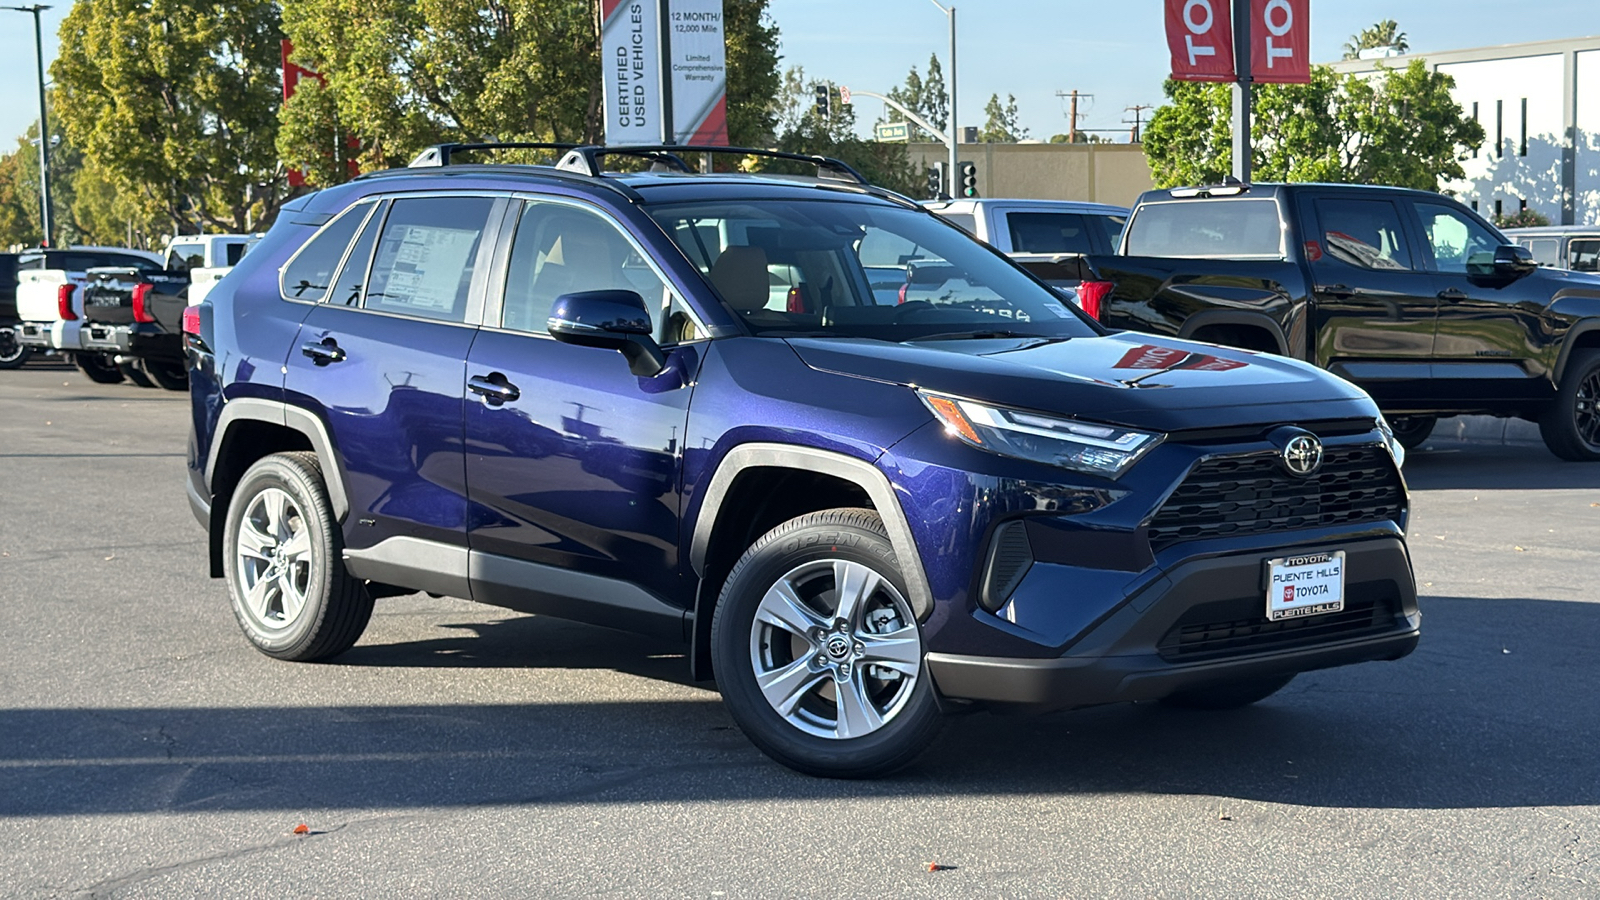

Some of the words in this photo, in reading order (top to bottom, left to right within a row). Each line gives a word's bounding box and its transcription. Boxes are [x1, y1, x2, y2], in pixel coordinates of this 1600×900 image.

[671, 12, 681, 21] 12
[683, 12, 721, 22] MONTH/
[675, 25, 700, 33] 12,000
[701, 25, 718, 33] Mile
[631, 4, 644, 80] VEHICLES
[673, 65, 723, 73] Comprehensive
[685, 74, 715, 82] Warranty
[617, 46, 630, 127] CERTIFIED
[634, 85, 646, 127] USED
[1290, 555, 1328, 565] TOYOTA
[1273, 571, 1314, 583] PUENTE
[1316, 566, 1340, 578] HILLS
[1296, 584, 1329, 597] TOYOTA
[1274, 607, 1312, 619] PUENTE
[1312, 602, 1340, 613] HILLS
